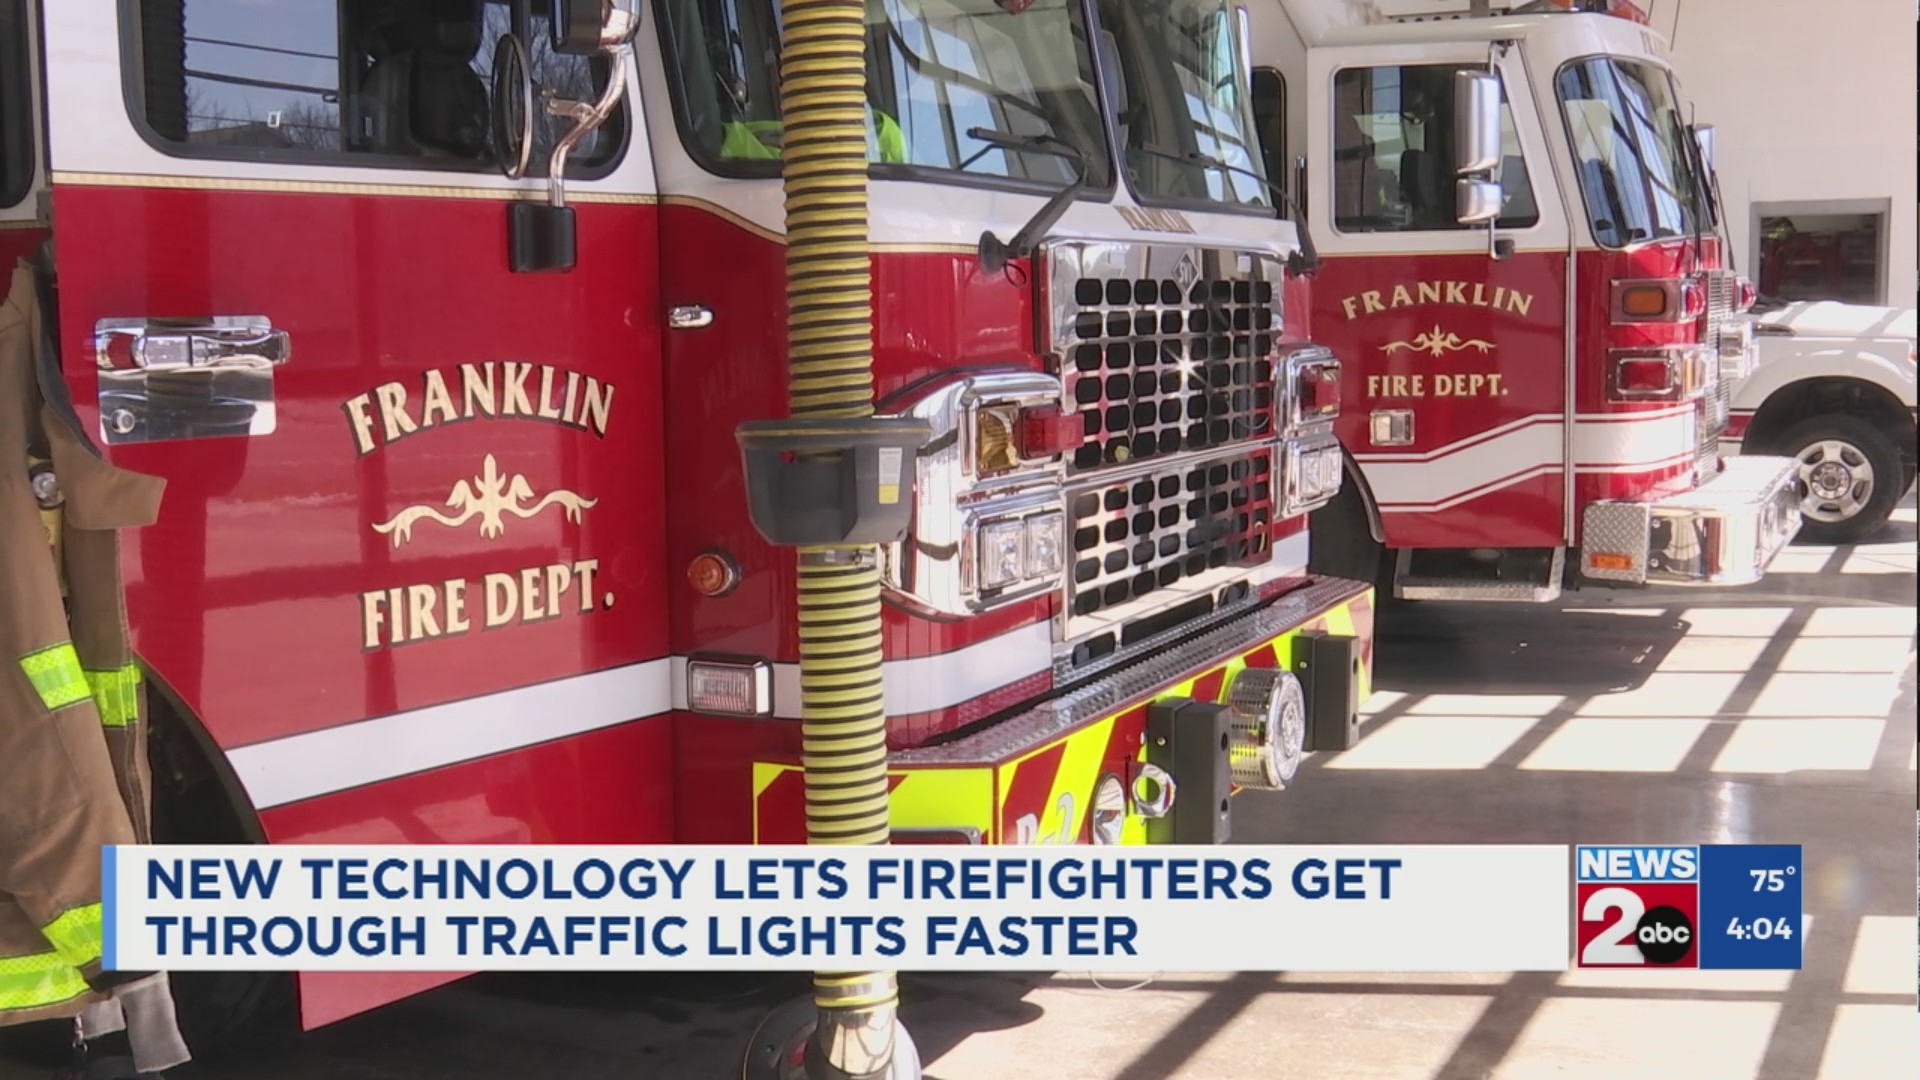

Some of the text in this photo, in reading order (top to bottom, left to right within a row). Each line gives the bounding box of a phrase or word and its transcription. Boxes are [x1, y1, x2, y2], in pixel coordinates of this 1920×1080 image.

[1341, 280, 1534, 321] FRANKLIN
[342, 361, 615, 455] FRANKLIN
[1367, 373, 1509, 397] FIRE DEPT.
[361, 559, 614, 650] FIRE DEPT.
